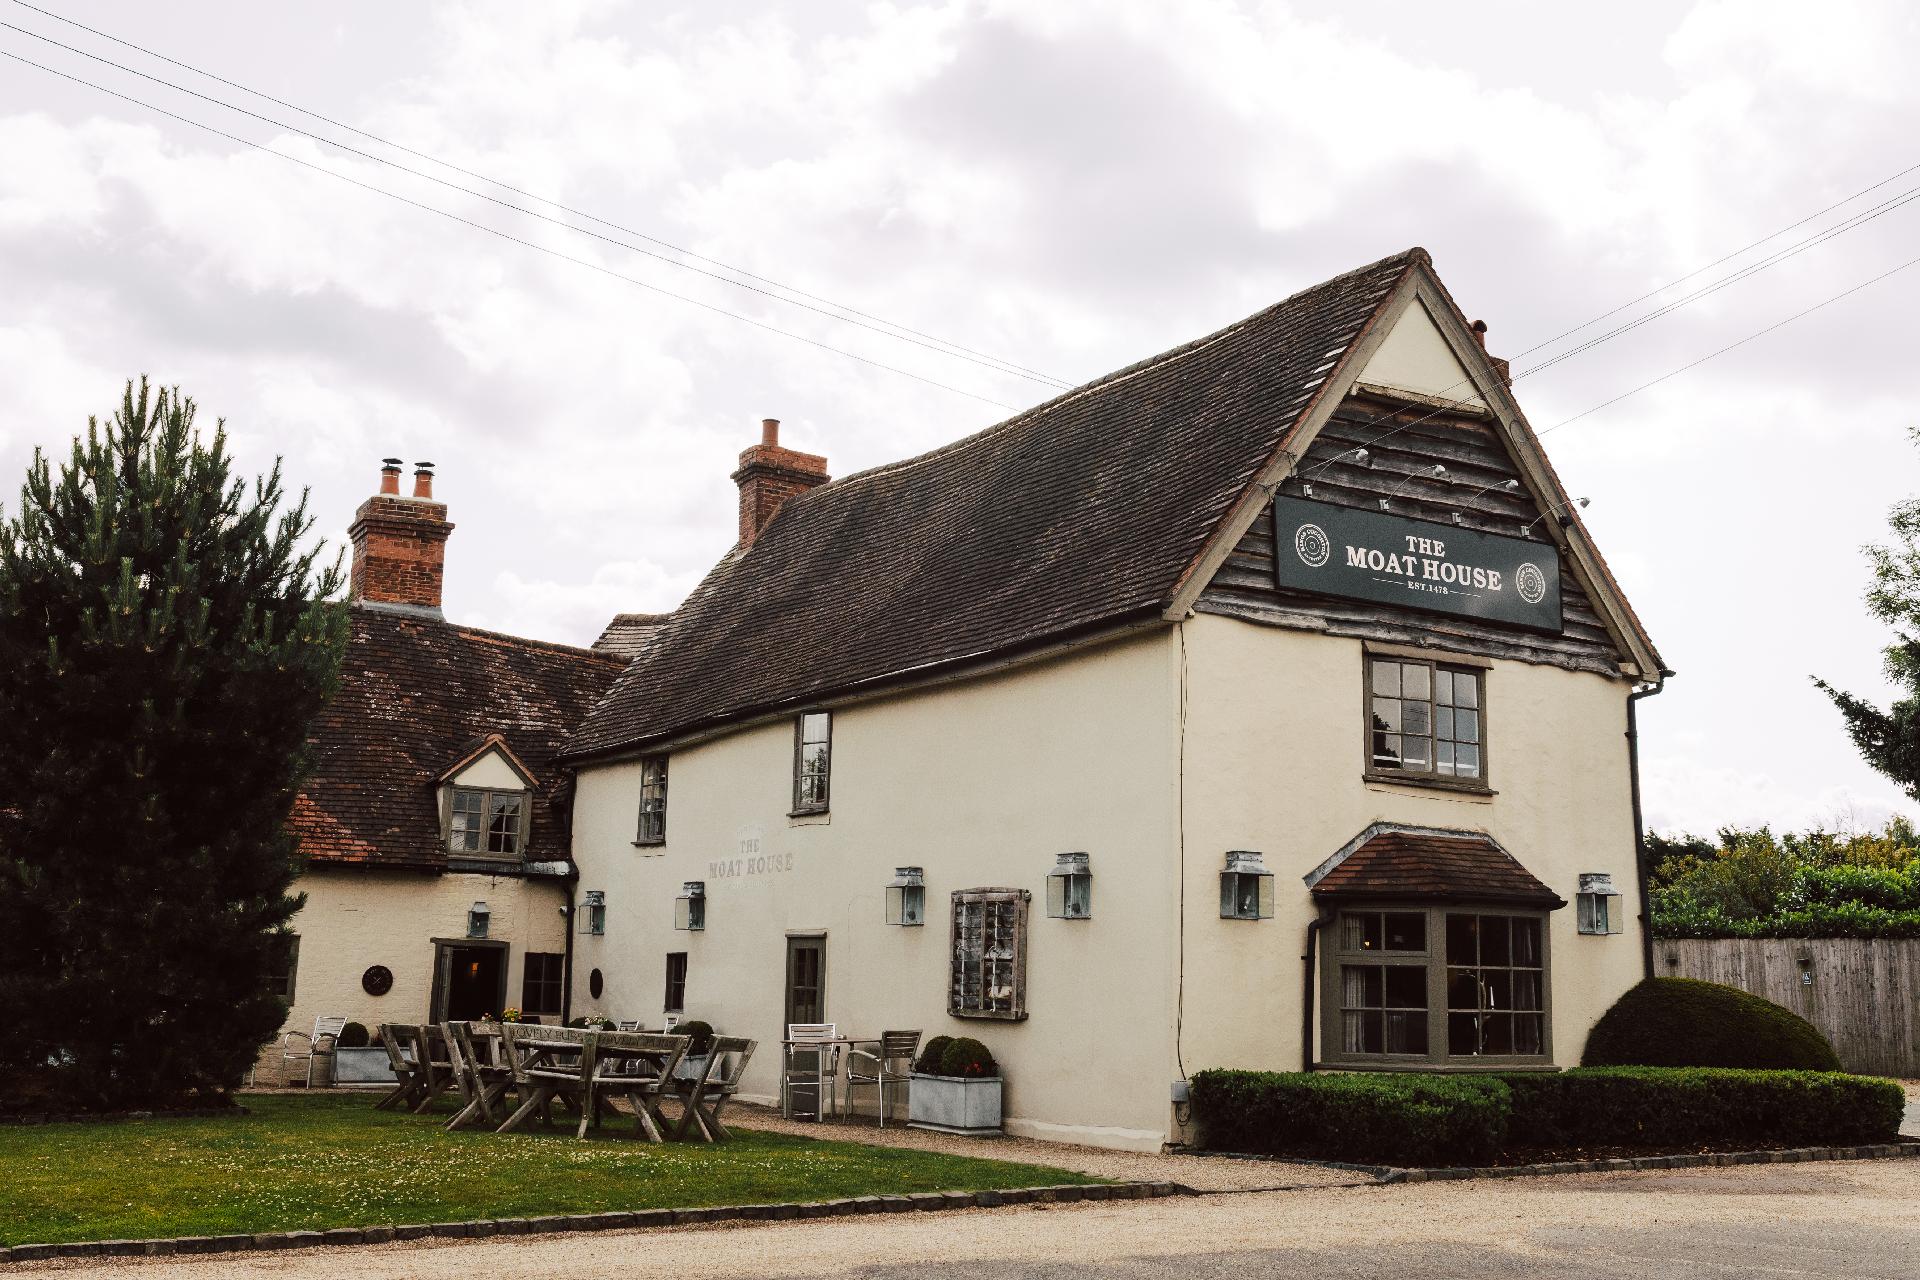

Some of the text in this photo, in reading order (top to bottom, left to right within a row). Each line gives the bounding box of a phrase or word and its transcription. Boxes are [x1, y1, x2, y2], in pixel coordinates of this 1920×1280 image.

[1405, 535, 1445, 557] THE
[1345, 545, 1417, 576] MOAT
[1422, 558, 1501, 591] HOUSE
[740, 839, 760, 853] THE
[709, 853, 793, 879] MOAT HOUSE
[511, 1026, 553, 1039] LOVELY
